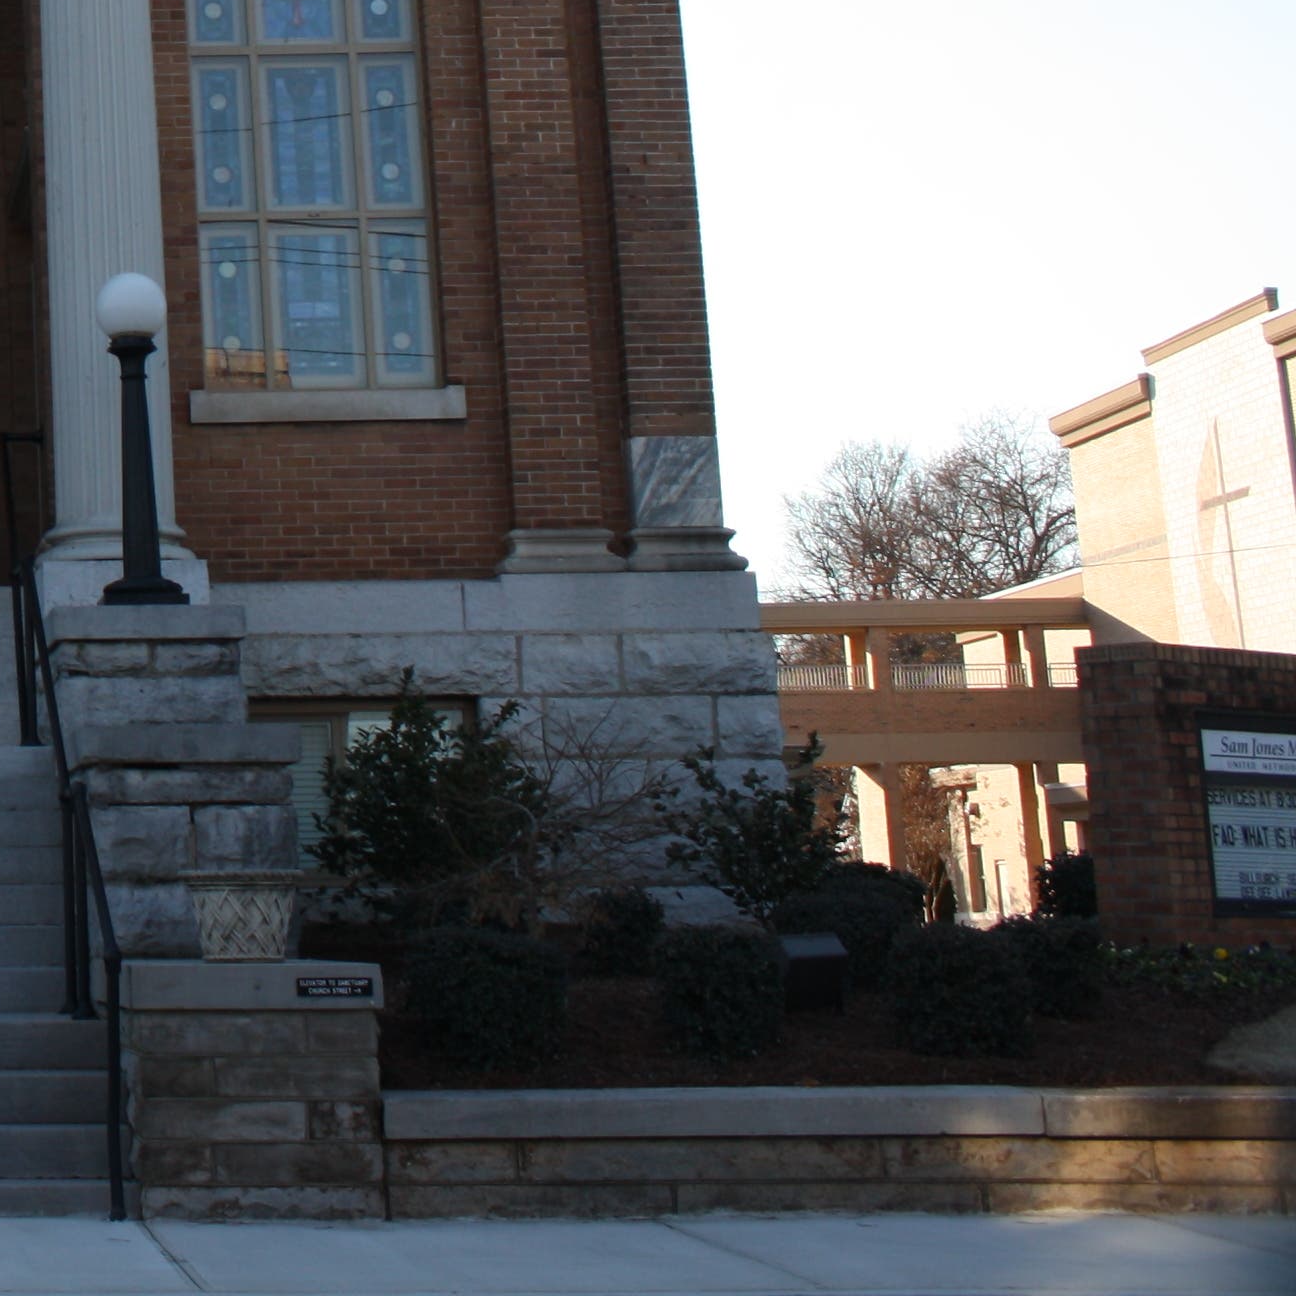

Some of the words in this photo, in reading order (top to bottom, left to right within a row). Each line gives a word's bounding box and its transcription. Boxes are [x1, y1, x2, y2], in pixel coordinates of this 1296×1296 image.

[1220, 736, 1249, 754] Sam
[1250, 738, 1285, 758] Jones
[1207, 787, 1257, 806] SERVICES
[1258, 790, 1271, 807] AT
[1241, 825, 1269, 848] WHAT
[1274, 826, 1287, 849] IS
[299, 979, 326, 987] ELEVATOR
[328, 979, 336, 987] TO
[337, 979, 369, 987] SANCTUARY
[308, 987, 331, 995] CHURCH
[332, 987, 352, 995] STREET
